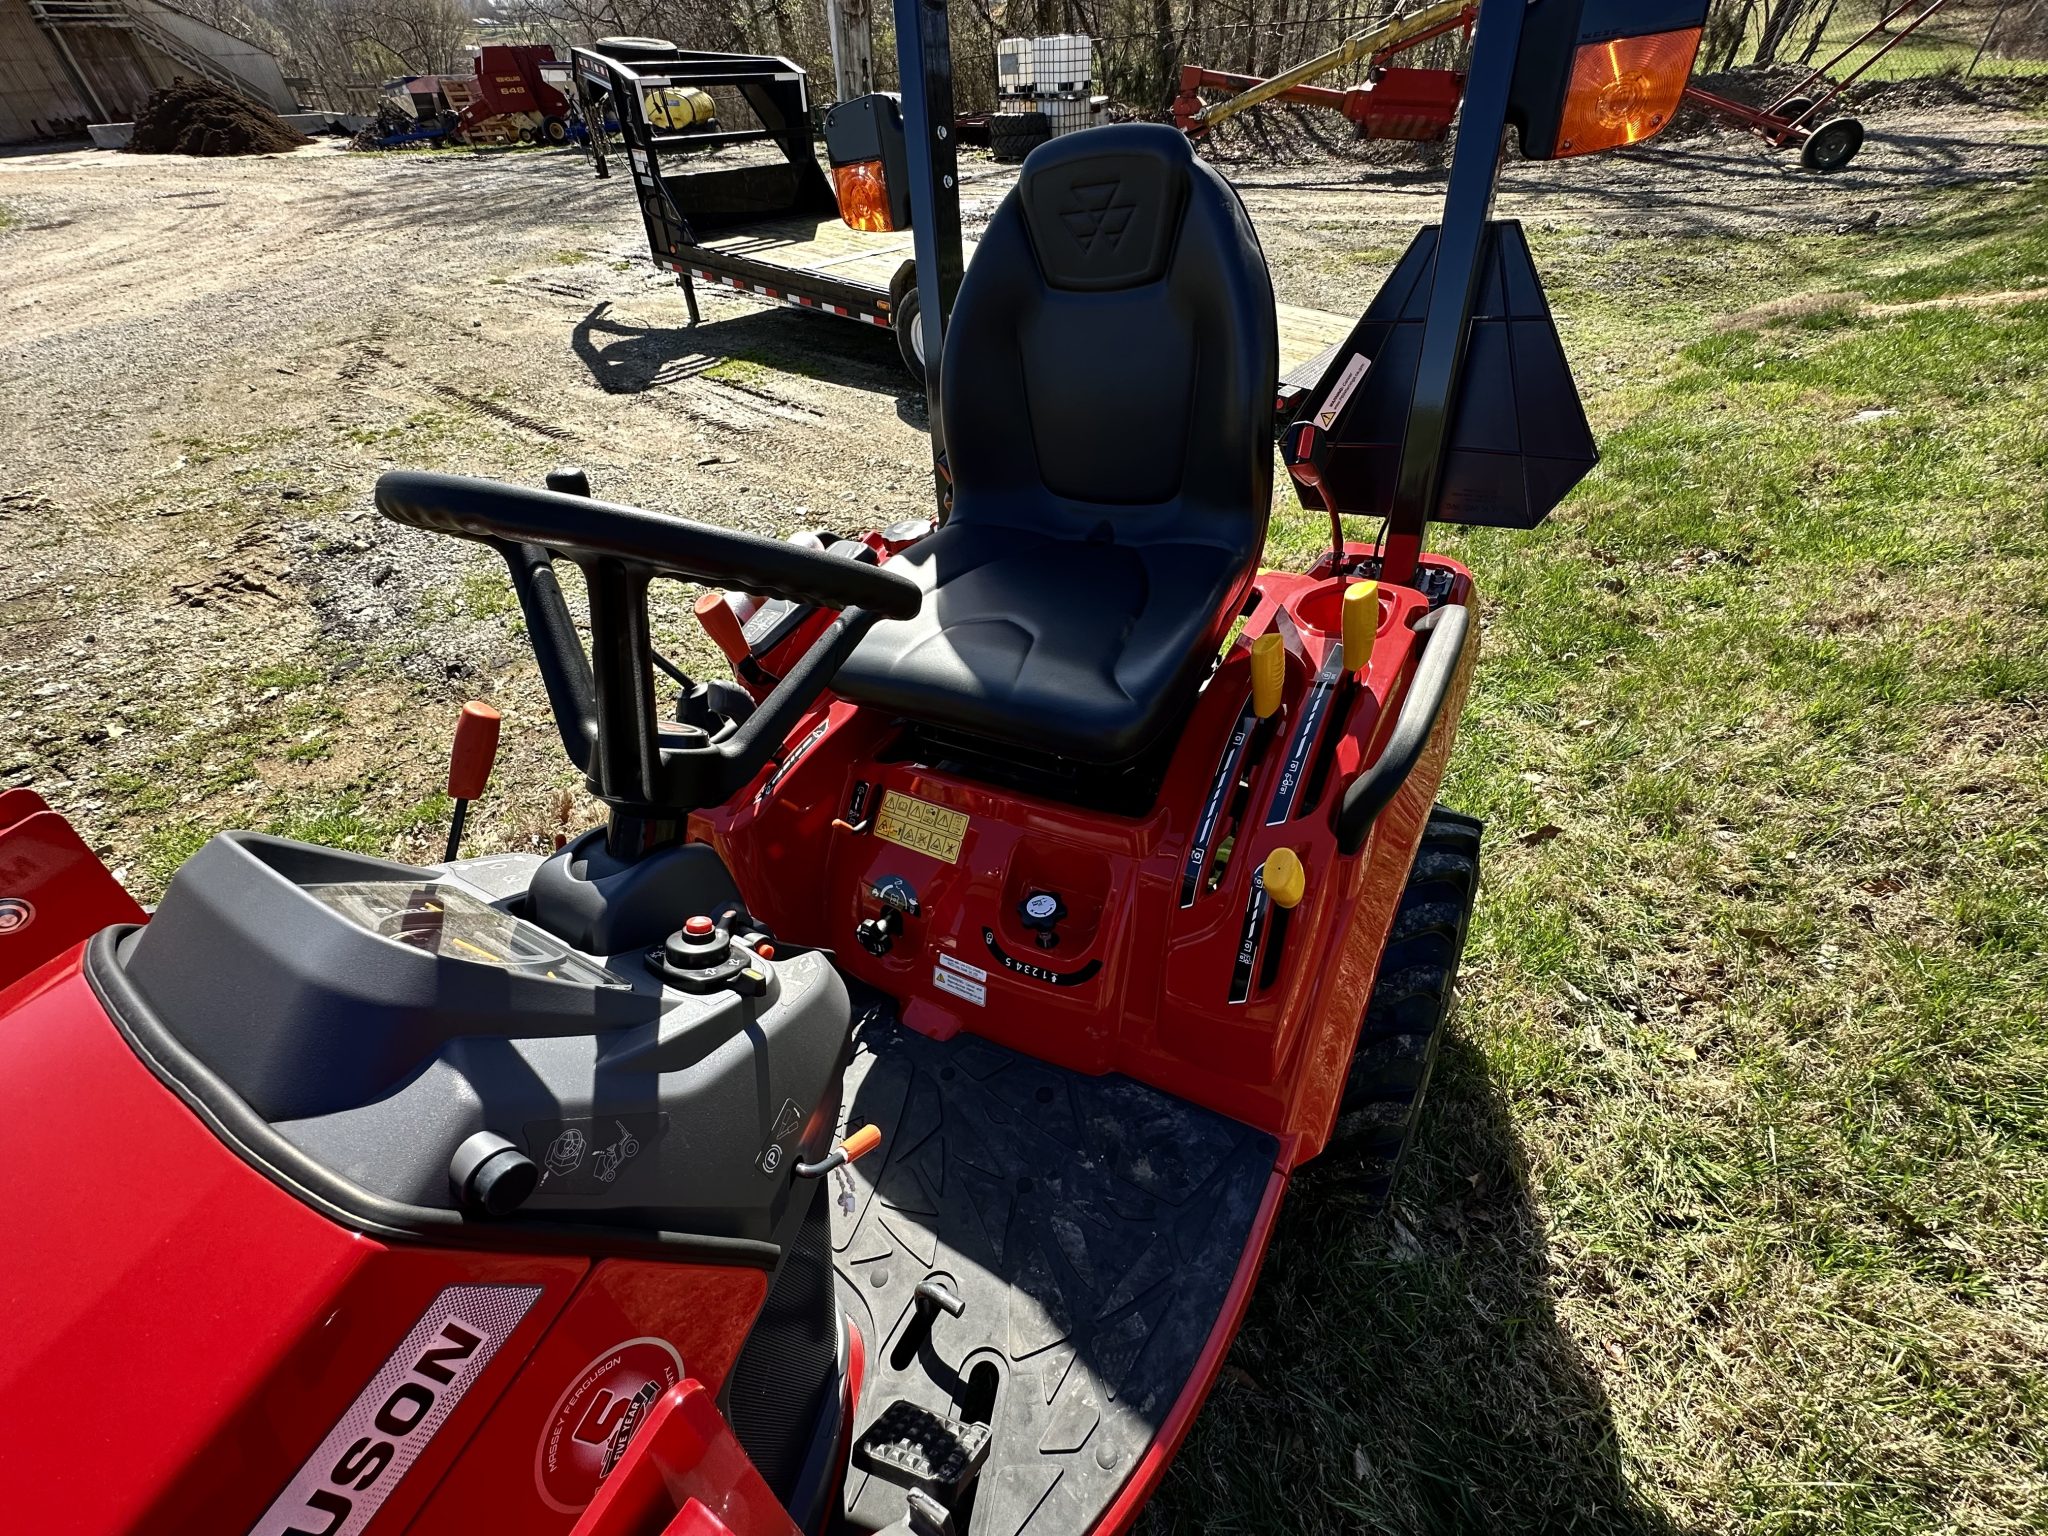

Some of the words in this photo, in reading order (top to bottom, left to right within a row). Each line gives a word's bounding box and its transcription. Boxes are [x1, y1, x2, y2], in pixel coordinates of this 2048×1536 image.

[548, 1418, 565, 1473] MASSEY
[564, 1356, 622, 1416] FERGUSON
[613, 1434, 629, 1461] FIVE
[622, 1401, 641, 1434] YEAR
